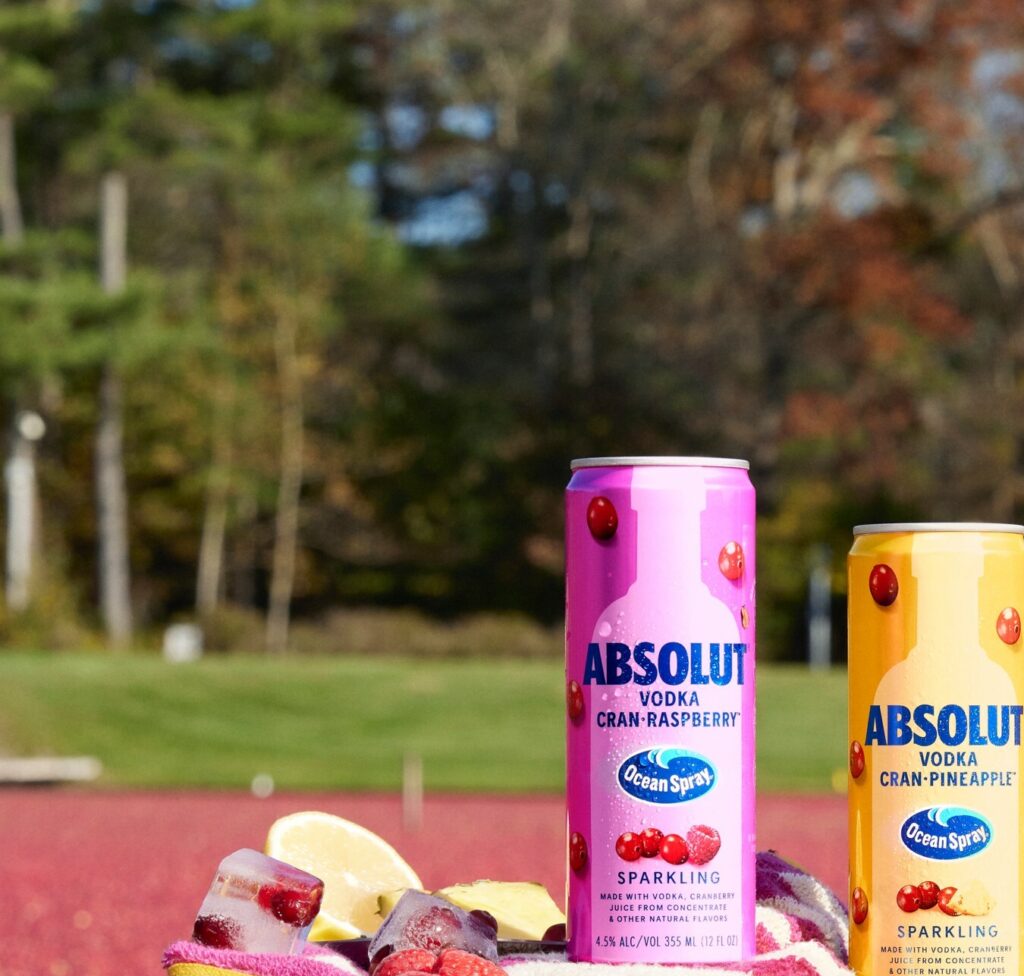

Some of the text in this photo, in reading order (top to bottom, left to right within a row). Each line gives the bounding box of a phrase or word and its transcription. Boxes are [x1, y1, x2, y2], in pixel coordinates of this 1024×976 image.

[583, 642, 747, 686] ABSOLUT
[640, 691, 700, 707] VODKA
[865, 704, 1024, 747] ABSOLUT
[919, 751, 978, 767] VODKA
[624, 764, 711, 795] Ocean Spray
[906, 822, 987, 851] Ocean Spray
[617, 871, 721, 884] SPARKLING
[600, 892, 735, 901] MADE WITH VODKA, CRANBERRY
[897, 925, 998, 938] SPARKLING
[595, 936, 616, 947] 4.5%
[619, 936, 661, 949] ALC/VOL
[664, 936, 681, 947] 355
[685, 936, 696, 947] ML
[701, 935, 713, 948] (12
[716, 936, 724, 947] FL
[931, 946, 965, 954] VODKA,
